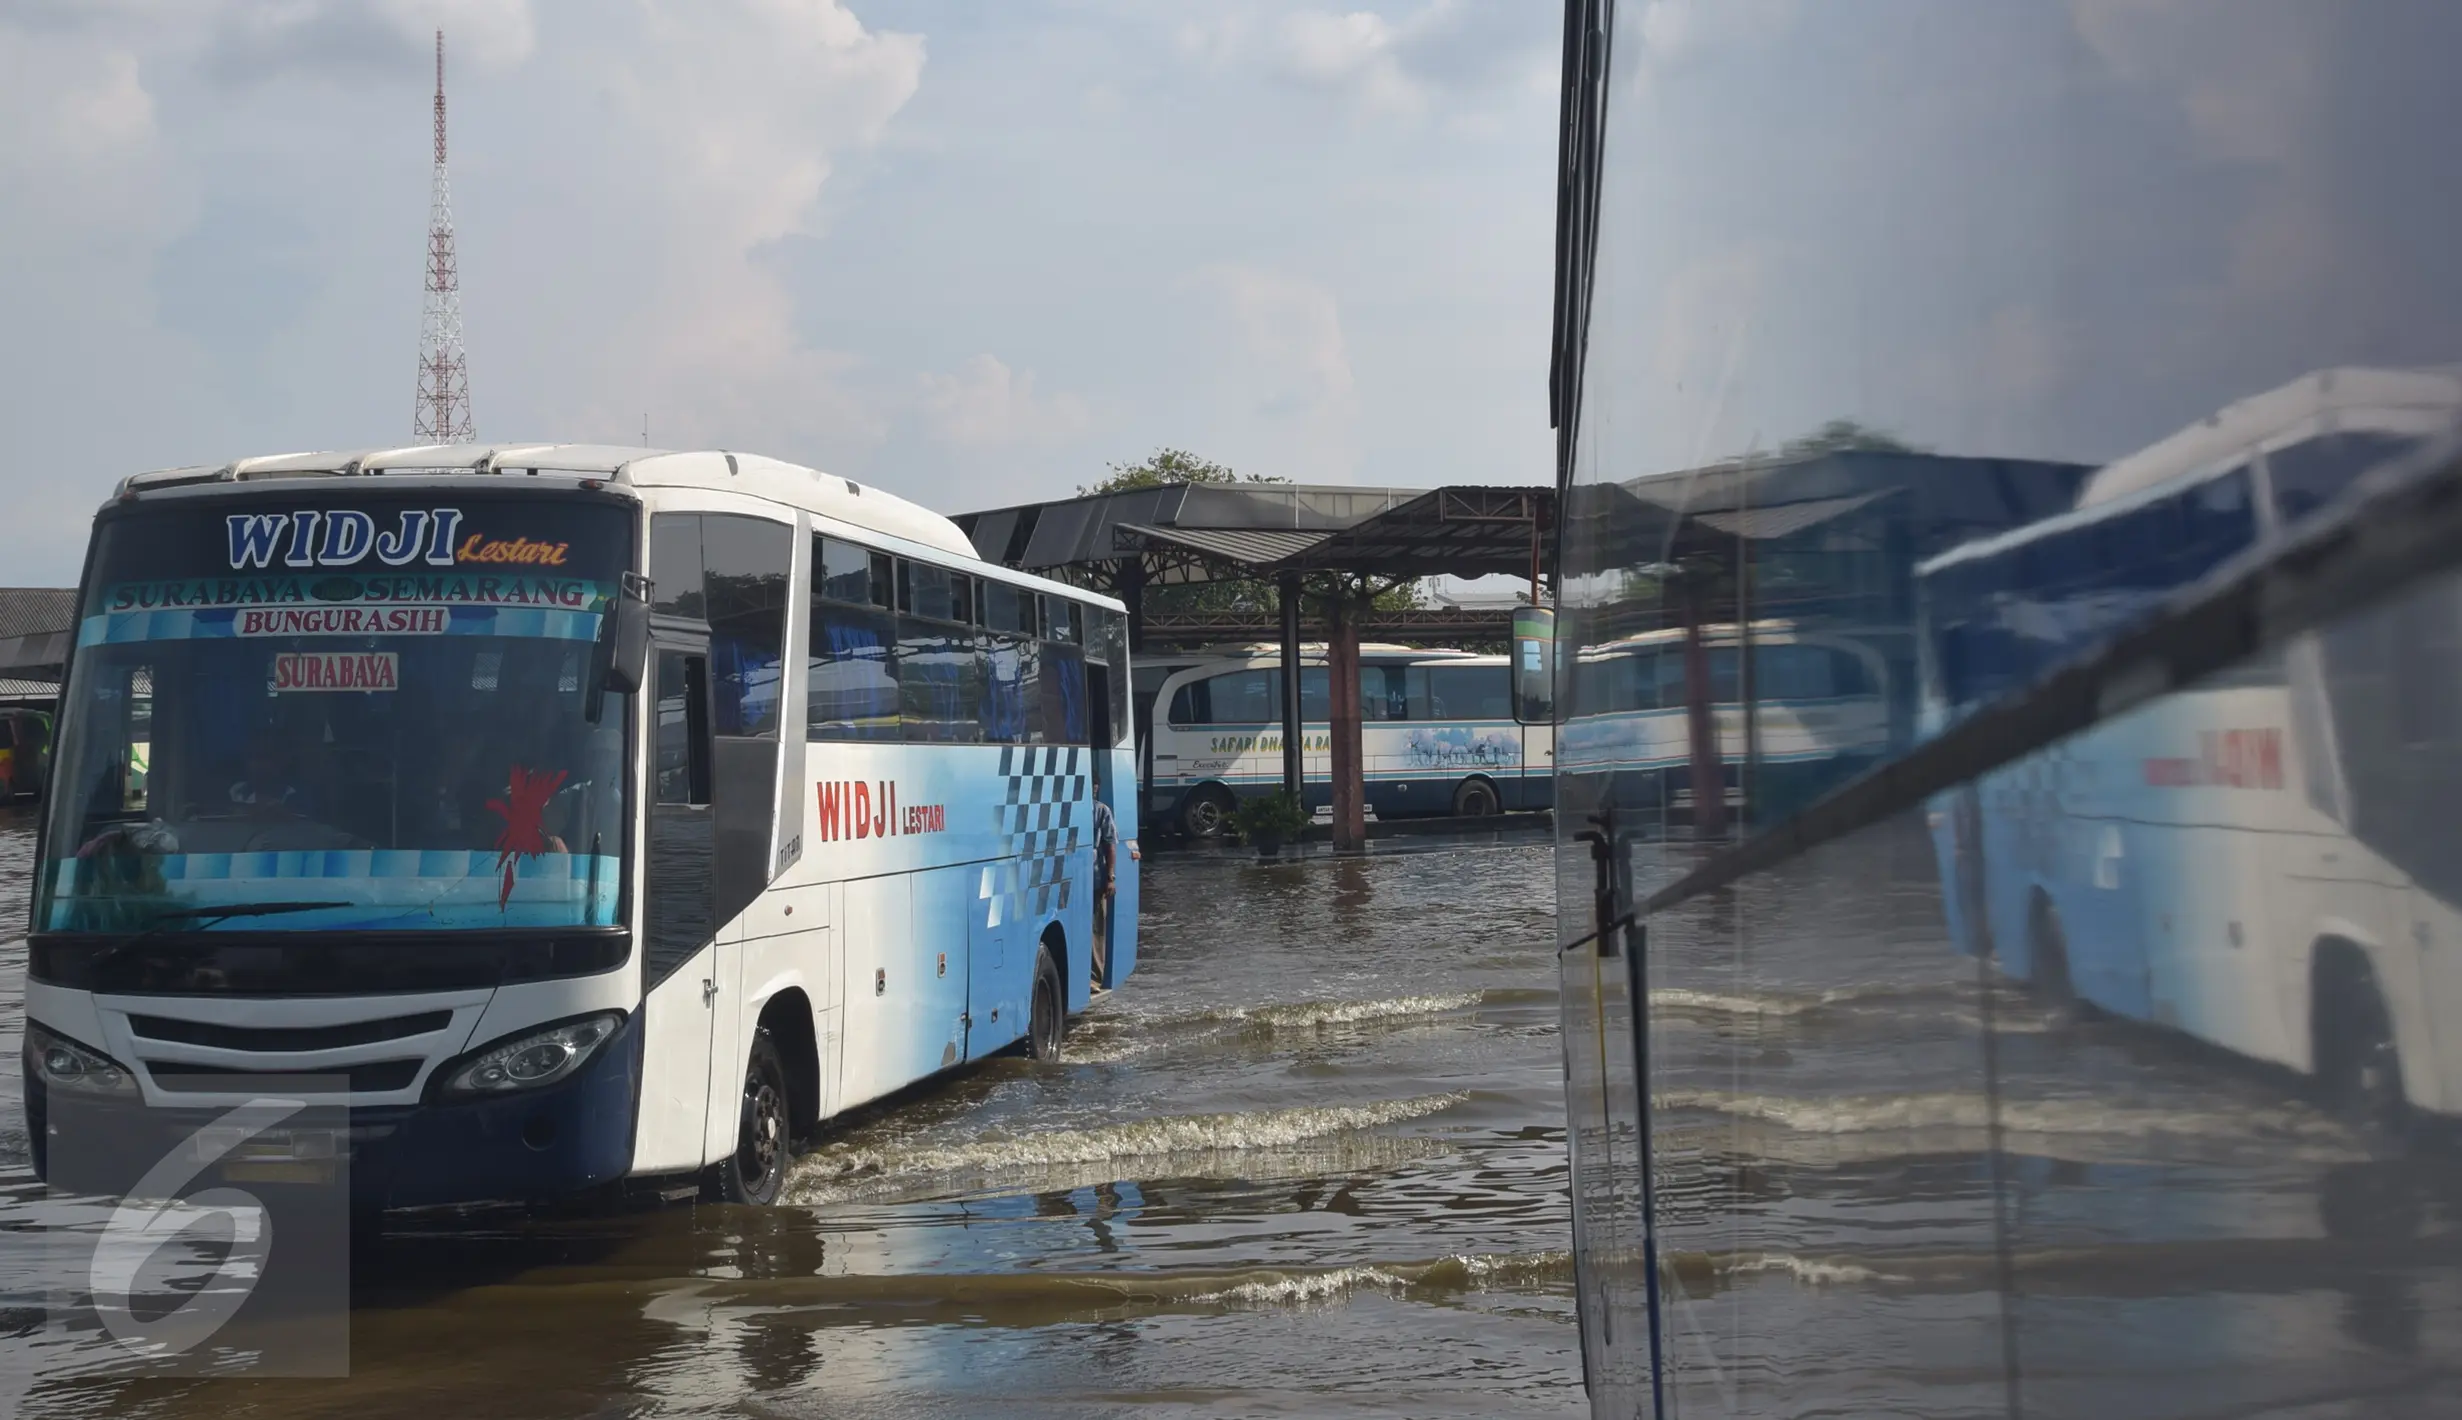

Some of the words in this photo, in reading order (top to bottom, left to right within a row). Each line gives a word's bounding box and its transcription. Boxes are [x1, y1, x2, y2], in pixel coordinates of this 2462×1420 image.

[226, 509, 463, 568] WIDJI
[457, 534, 567, 566] Lestari
[113, 580, 303, 610] SURABAYA
[364, 577, 584, 605] SEMARANG
[242, 609, 444, 633] BUNGURASIH
[275, 656, 395, 689] SURABAYA
[1211, 737, 1256, 753] SAFARI
[1261, 736, 1311, 752] DHAA
[817, 781, 896, 842] WIDJI
[903, 804, 945, 834] LESTARI
